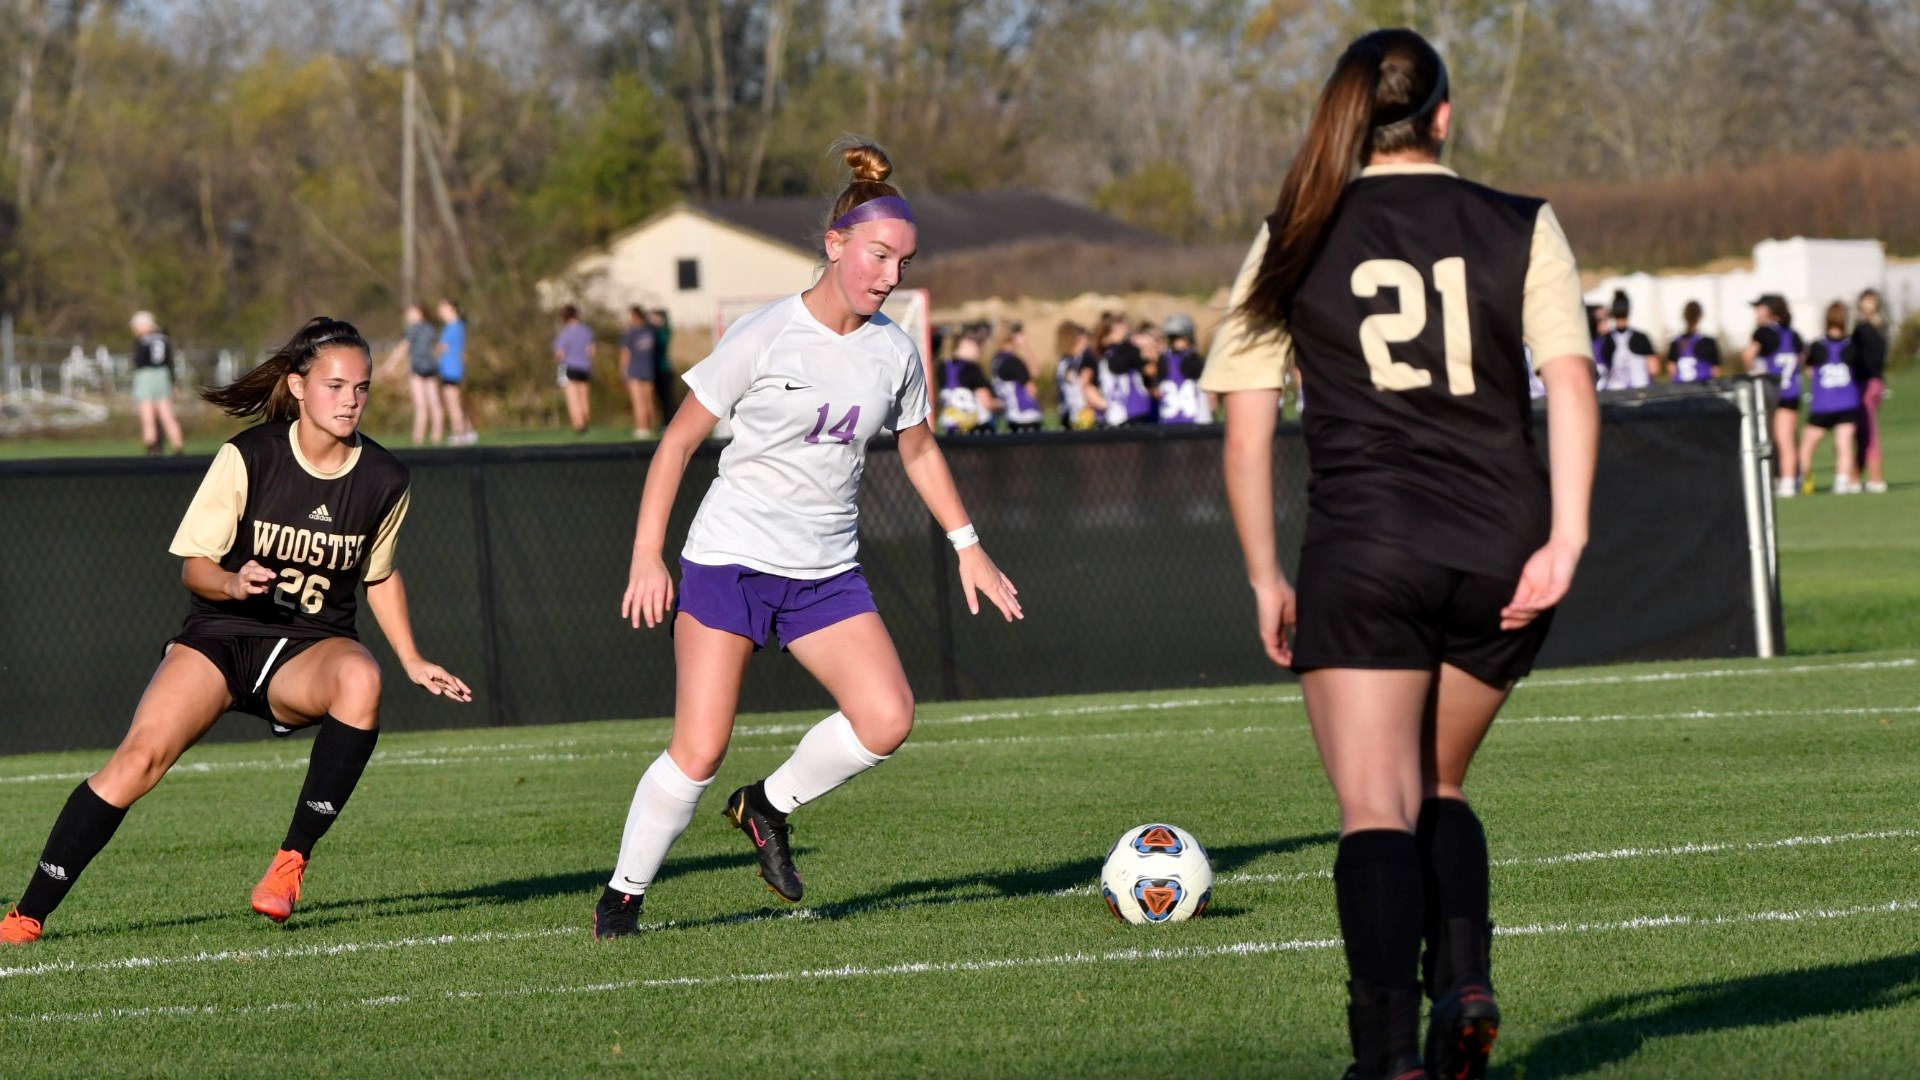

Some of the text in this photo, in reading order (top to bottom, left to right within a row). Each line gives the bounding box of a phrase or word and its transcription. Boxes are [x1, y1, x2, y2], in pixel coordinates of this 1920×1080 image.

[1351, 256, 1476, 396] 21
[1774, 352, 1798, 390] 7
[803, 402, 861, 445] 14
[308, 513, 333, 523] adidas
[273, 567, 331, 614] 26
